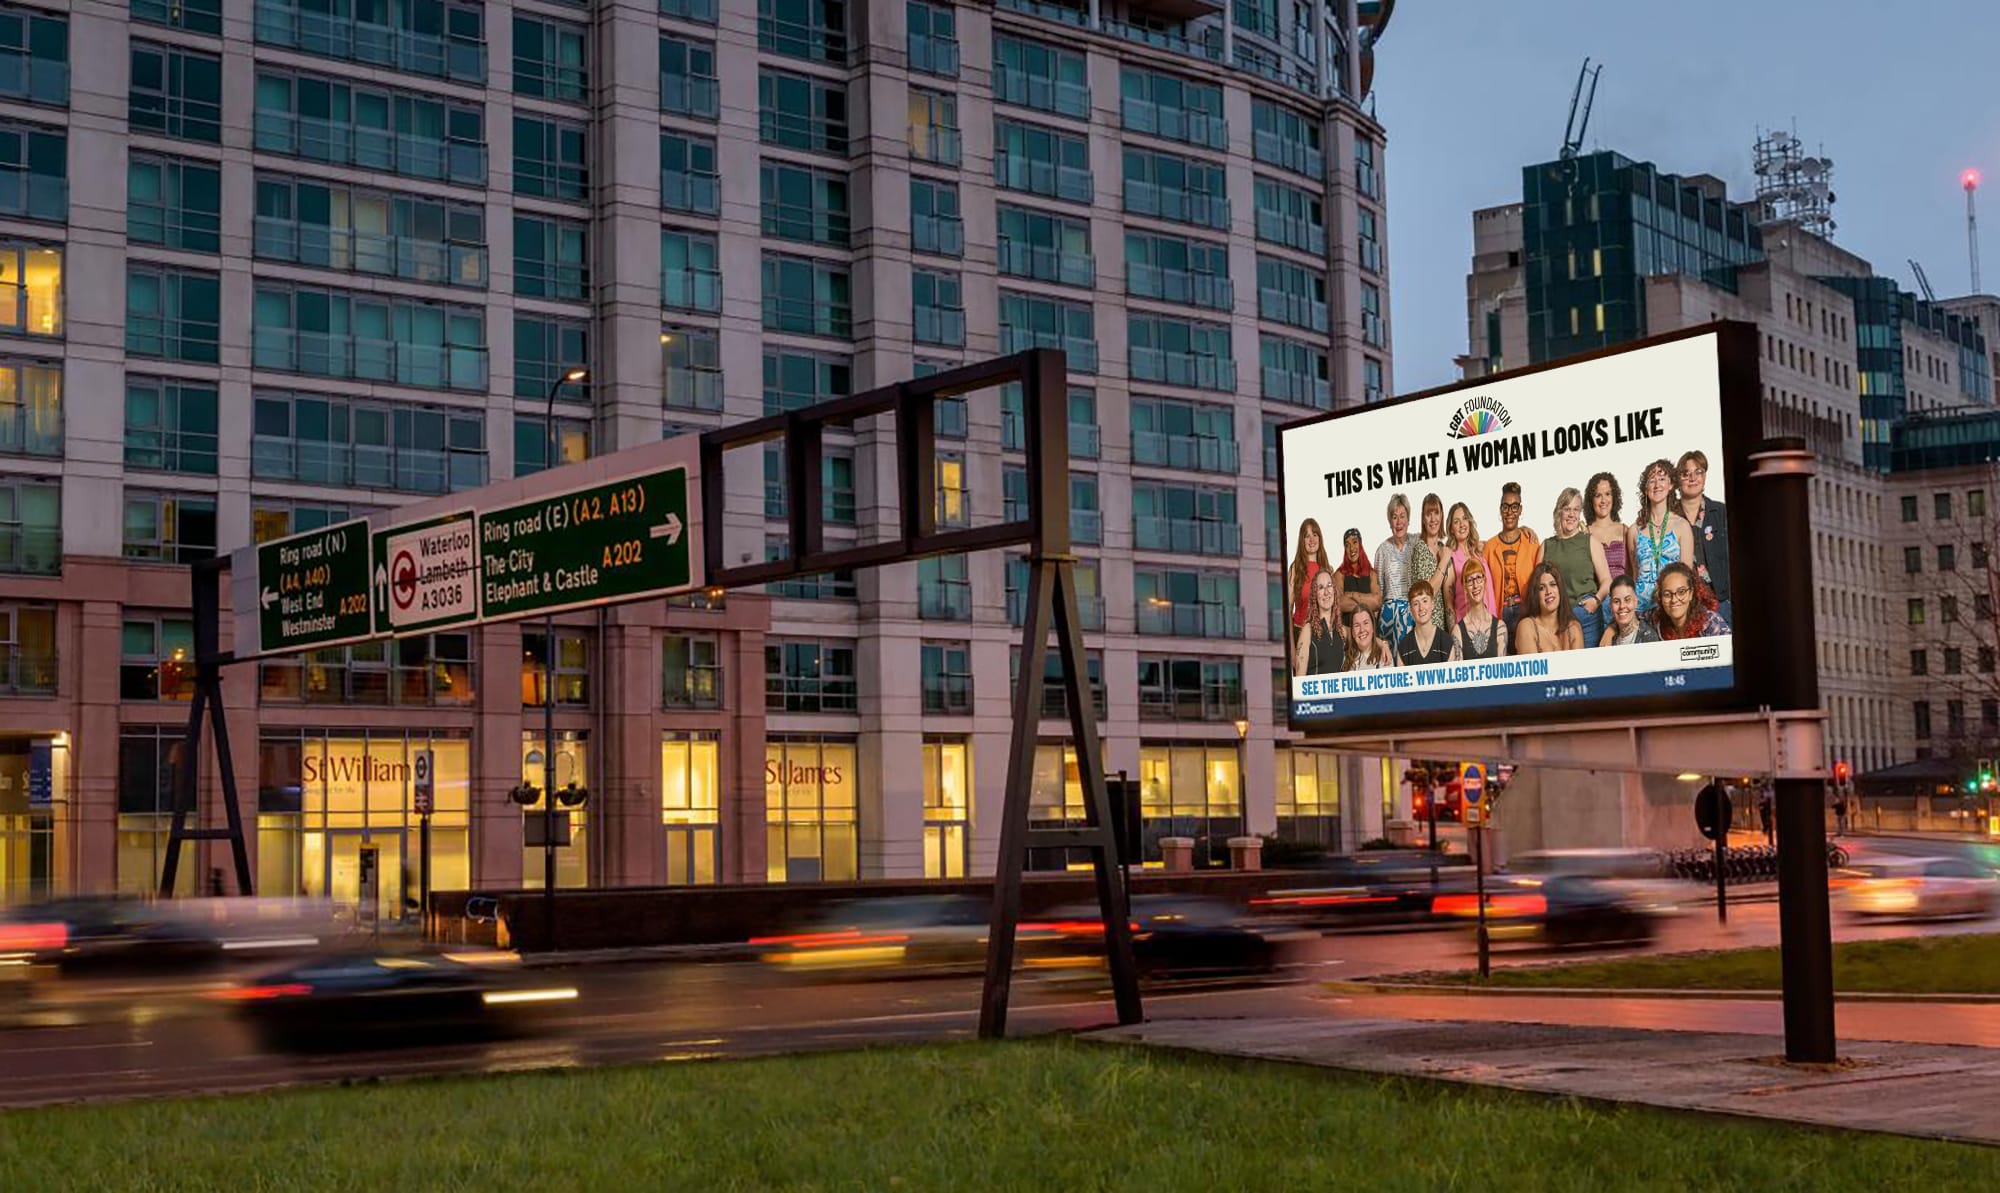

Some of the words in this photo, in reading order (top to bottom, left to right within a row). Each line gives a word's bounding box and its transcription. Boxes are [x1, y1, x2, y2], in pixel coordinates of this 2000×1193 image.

[1447, 407, 1465, 439] LGBT
[1464, 396, 1512, 428] FOUNDATION
[1324, 467, 1363, 498] THIS
[1366, 463, 1384, 491] IS
[1387, 451, 1440, 486] WHAT
[1445, 449, 1459, 476] A
[1462, 432, 1536, 472] WOMAN
[1541, 418, 1609, 458] LOOKS
[1614, 406, 1664, 444] LIKE
[484, 521, 510, 543] Ring
[513, 511, 542, 536] road
[545, 502, 569, 531] (E)
[609, 484, 645, 515] A13)
[280, 546, 300, 566] Ring
[302, 538, 323, 560] road
[325, 530, 347, 556] (N)
[420, 531, 470, 558] Waterloo
[602, 540, 642, 569] A202
[305, 563, 331, 588] A40)
[420, 556, 469, 586] Lambeth
[484, 555, 506, 577] The
[508, 549, 535, 572] City
[421, 584, 463, 611] A3036
[486, 576, 539, 604] Elephant
[543, 574, 552, 592] &
[555, 564, 599, 591] Castle
[281, 594, 303, 615] West
[306, 590, 324, 611] End
[340, 593, 367, 615] A202
[282, 613, 336, 637] Westminster
[1301, 680, 1320, 696] SEE
[1321, 678, 1340, 694] THE
[1341, 675, 1366, 693] FULL
[1367, 671, 1413, 690] PICTURE:
[1416, 658, 1548, 688] WWW.LGBT.FOUNDATION
[1558, 685, 1575, 697] Jan
[303, 755, 327, 783] St
[329, 754, 412, 783] William
[764, 759, 784, 785] St
[787, 759, 842, 786] James
